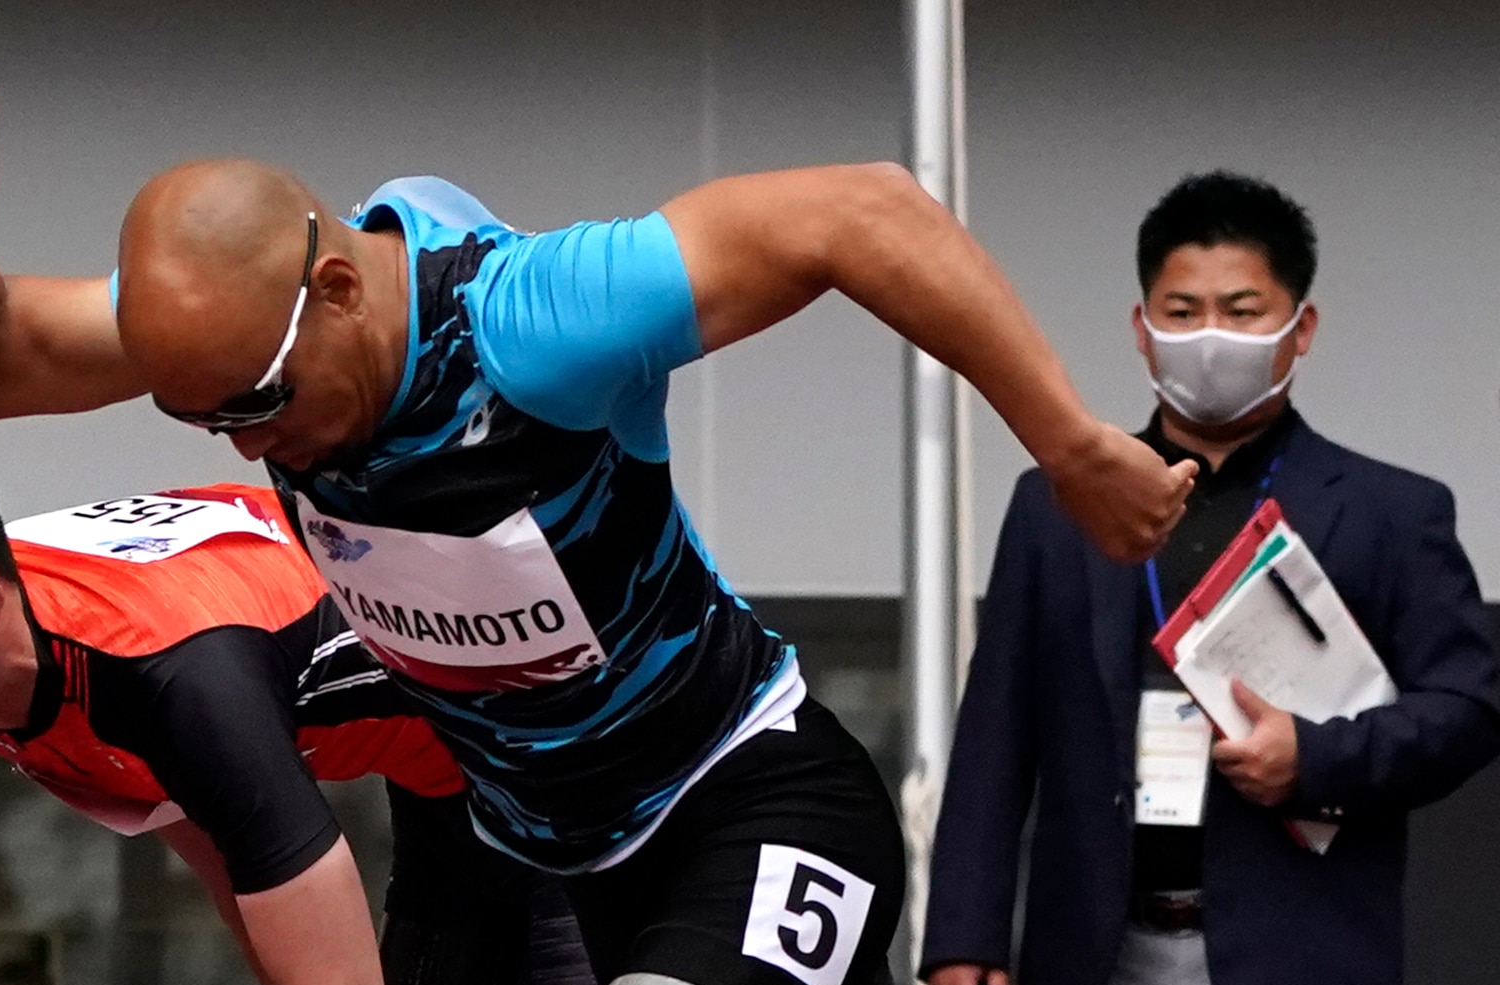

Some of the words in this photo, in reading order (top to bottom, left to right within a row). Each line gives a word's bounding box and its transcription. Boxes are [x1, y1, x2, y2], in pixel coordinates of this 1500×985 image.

[71, 498, 208, 527] 155
[331, 580, 566, 647] YAMAMOTO
[777, 861, 846, 971] 5
